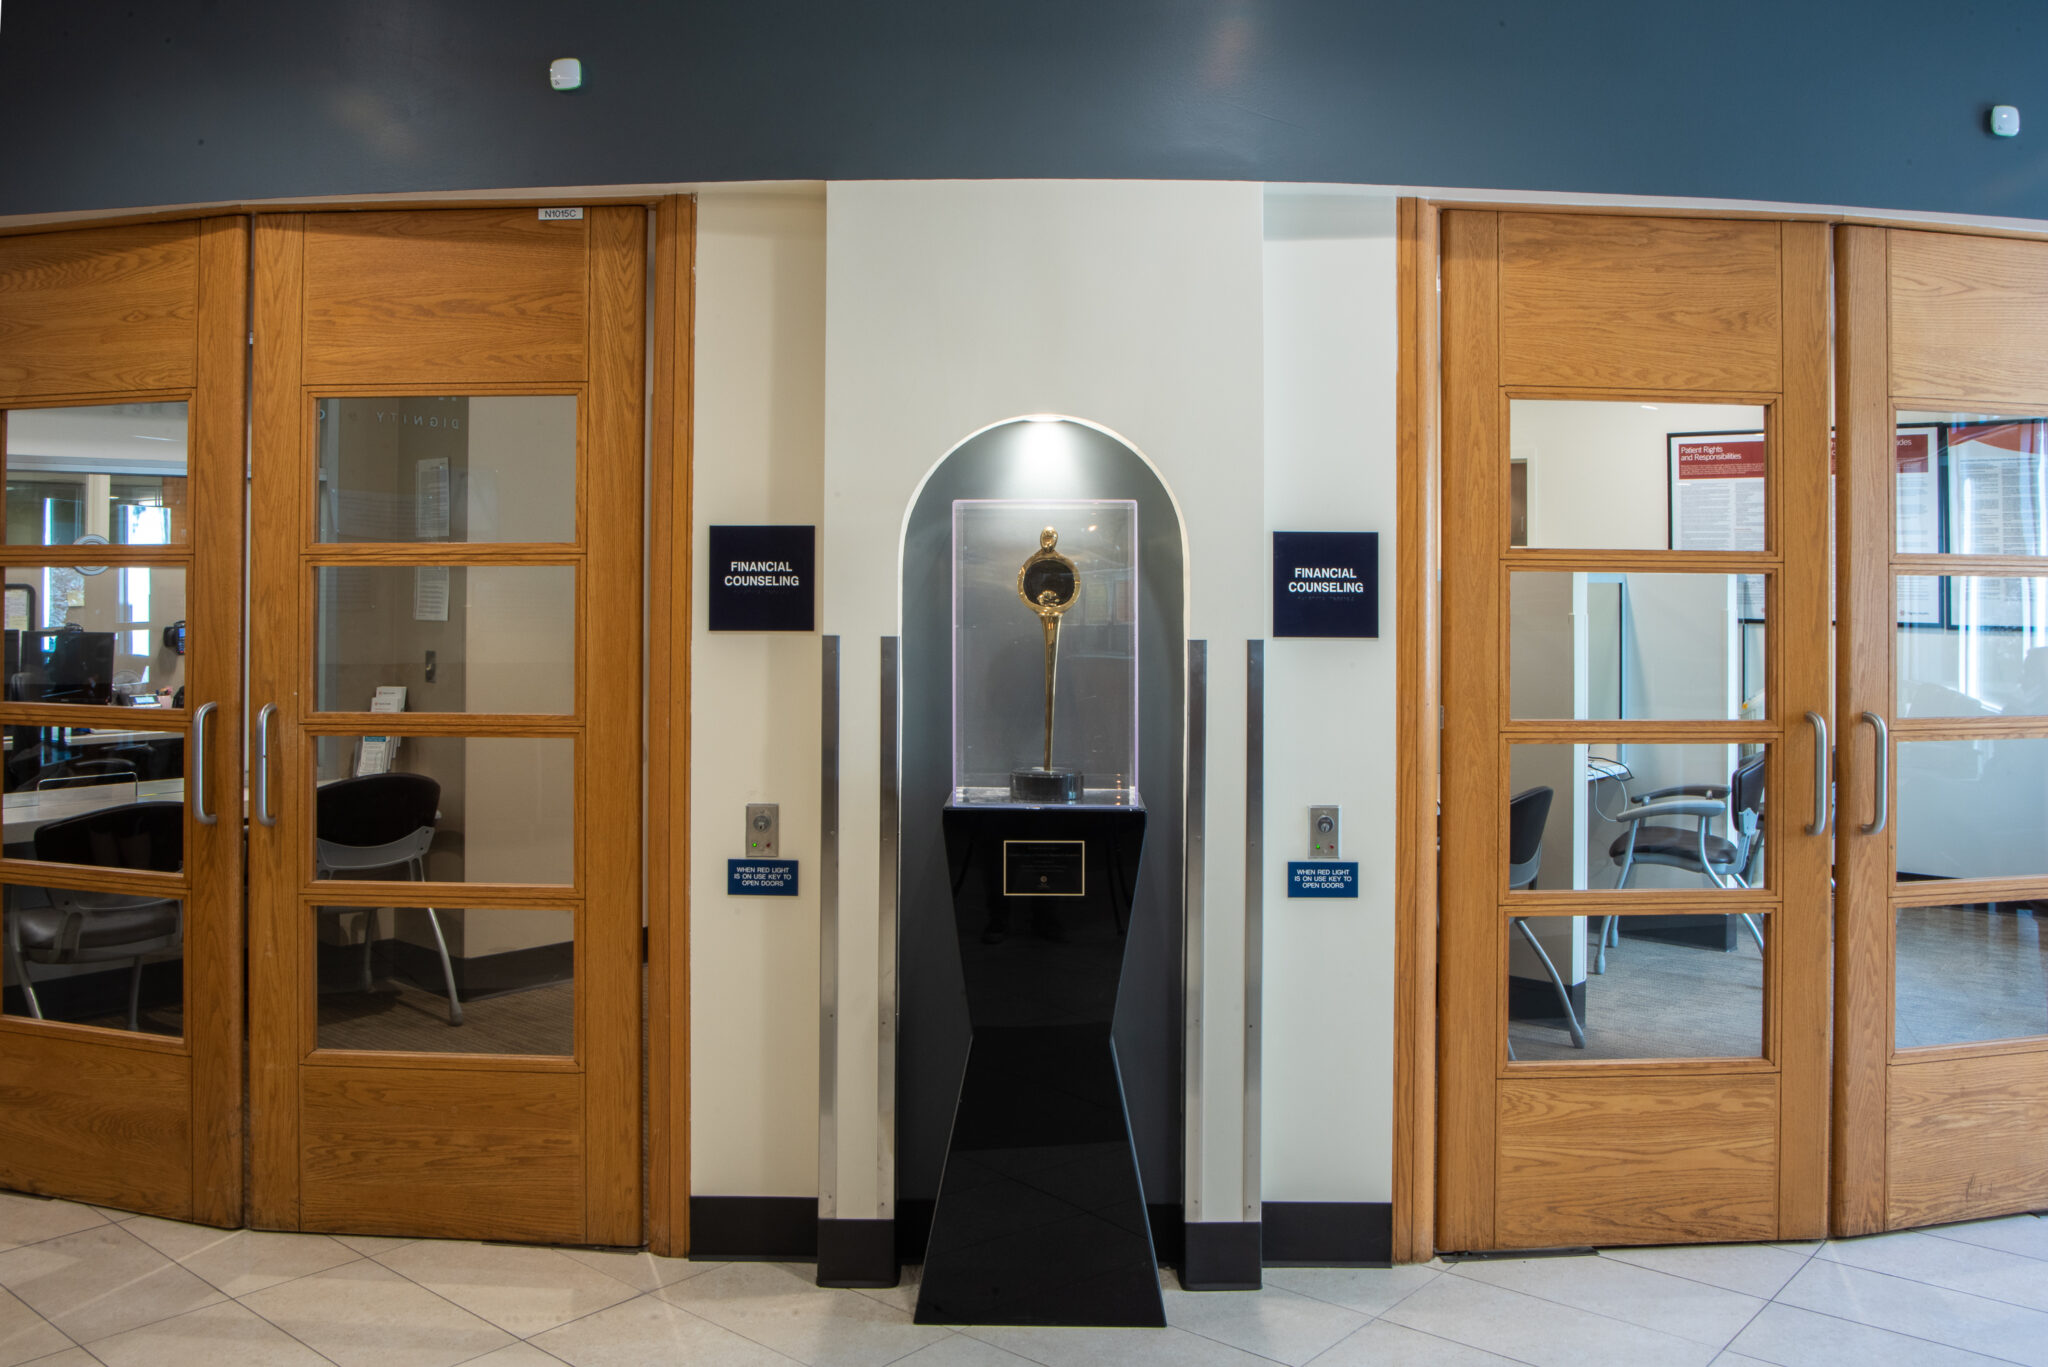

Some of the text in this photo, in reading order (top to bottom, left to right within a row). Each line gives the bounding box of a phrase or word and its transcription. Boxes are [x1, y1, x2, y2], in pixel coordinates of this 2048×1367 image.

[544, 209, 577, 218] N1015C
[1703, 446, 1723, 454] Rights
[1694, 453, 1742, 461] Responsibilities
[730, 561, 793, 572] FINANCIAL
[1294, 567, 1357, 579] FINANCIAL
[724, 575, 800, 587] COUNSELING
[1288, 581, 1364, 593] COUNSELING
